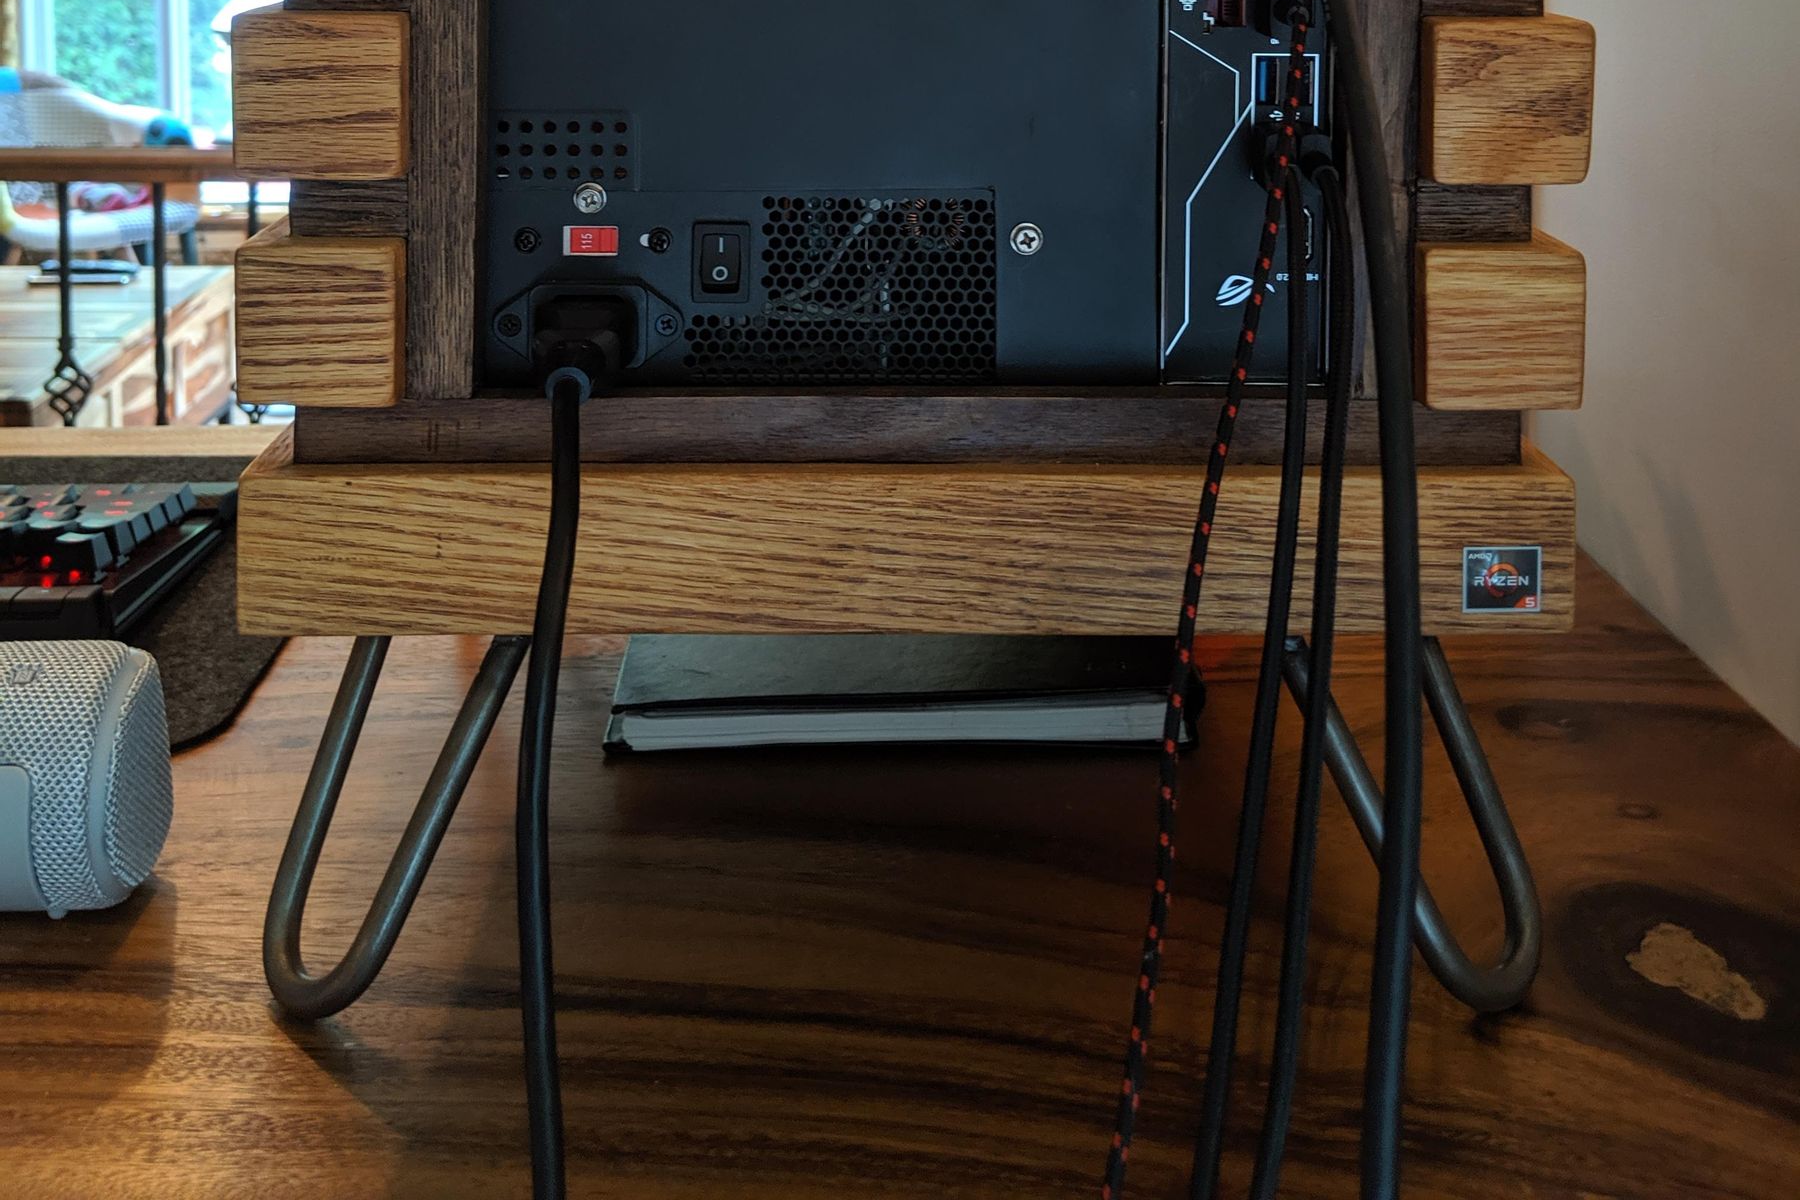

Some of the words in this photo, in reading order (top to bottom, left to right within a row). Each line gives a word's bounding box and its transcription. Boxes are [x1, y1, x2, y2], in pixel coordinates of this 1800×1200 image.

[580, 233, 593, 250] 115
[1468, 552, 1487, 560] AMD
[1473, 575, 1529, 586] RYZEN
[1525, 596, 1536, 608] 5
